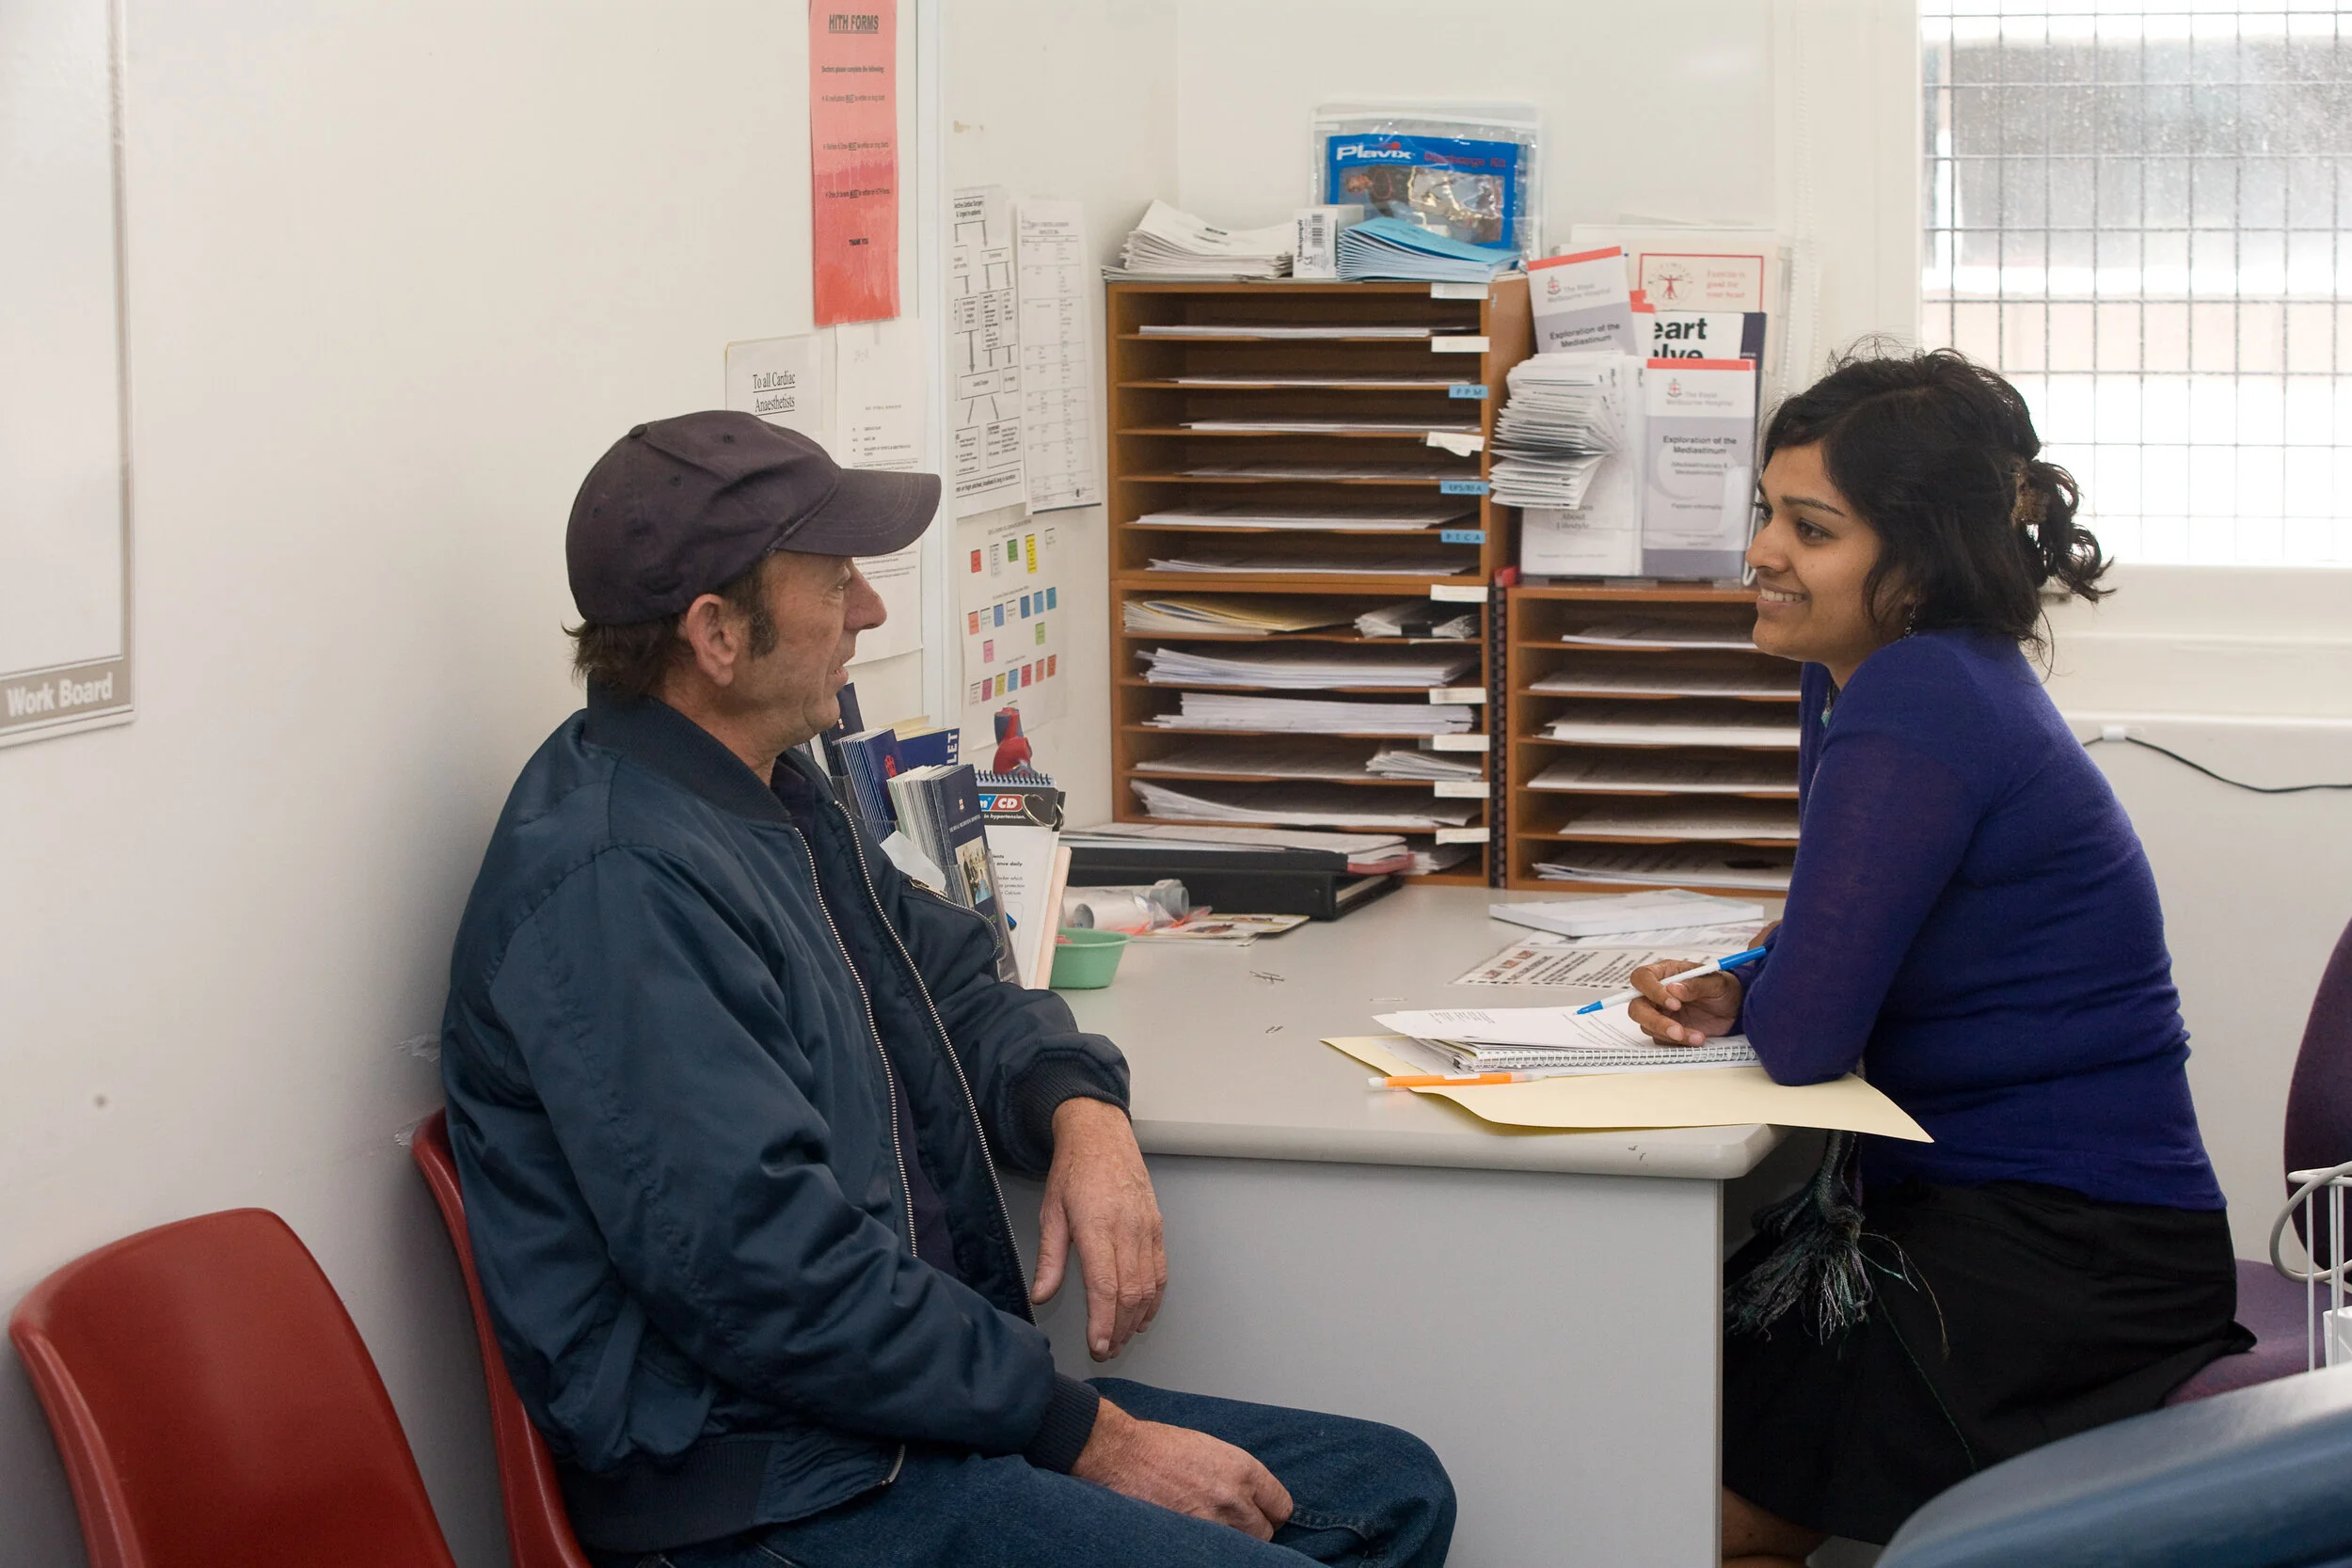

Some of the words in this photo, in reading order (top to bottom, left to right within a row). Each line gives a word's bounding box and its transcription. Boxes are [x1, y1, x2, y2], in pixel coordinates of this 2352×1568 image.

[829, 14, 849, 30] HITH
[850, 14, 879, 30] FORMS
[1336, 143, 1411, 161] Plavix
[1424, 151, 1486, 167] Discharge
[1549, 326, 1596, 341] Exploration
[1597, 324, 1605, 332] of
[1654, 318, 1708, 340] eart
[1561, 334, 1612, 348] Mediastinum
[1654, 343, 1703, 358] lve
[753, 374, 762, 388] To
[771, 371, 796, 387] Cardiac
[755, 393, 795, 413] Anaesthetists
[1662, 435, 1711, 444] Exploration
[1724, 436, 1738, 445] the
[1673, 446, 1727, 454] Mediastinum
[7, 682, 55, 718] Work
[59, 671, 114, 708] Board
[946, 733, 958, 765] LET
[997, 798, 1018, 809] CD
